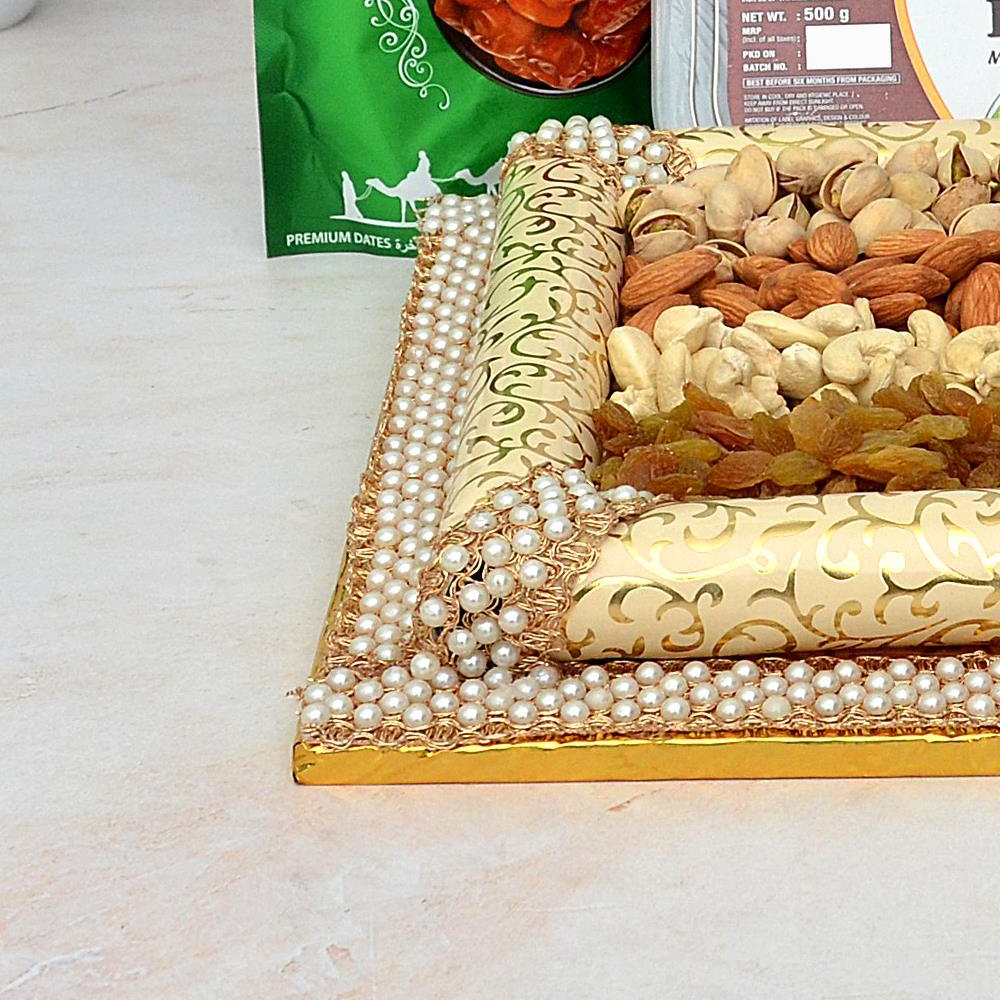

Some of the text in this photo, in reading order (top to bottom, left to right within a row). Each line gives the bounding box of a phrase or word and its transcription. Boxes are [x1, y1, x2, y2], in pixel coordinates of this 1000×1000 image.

[742, 12, 764, 23] NET
[767, 11, 787, 22] WT.
[804, 7, 834, 21] 500
[839, 8, 850, 23] g
[742, 27, 762, 36] MRP
[742, 49, 776, 60] PKD ON
[743, 63, 771, 72] BATCH
[286, 231, 391, 249] PREMIUM DATES
